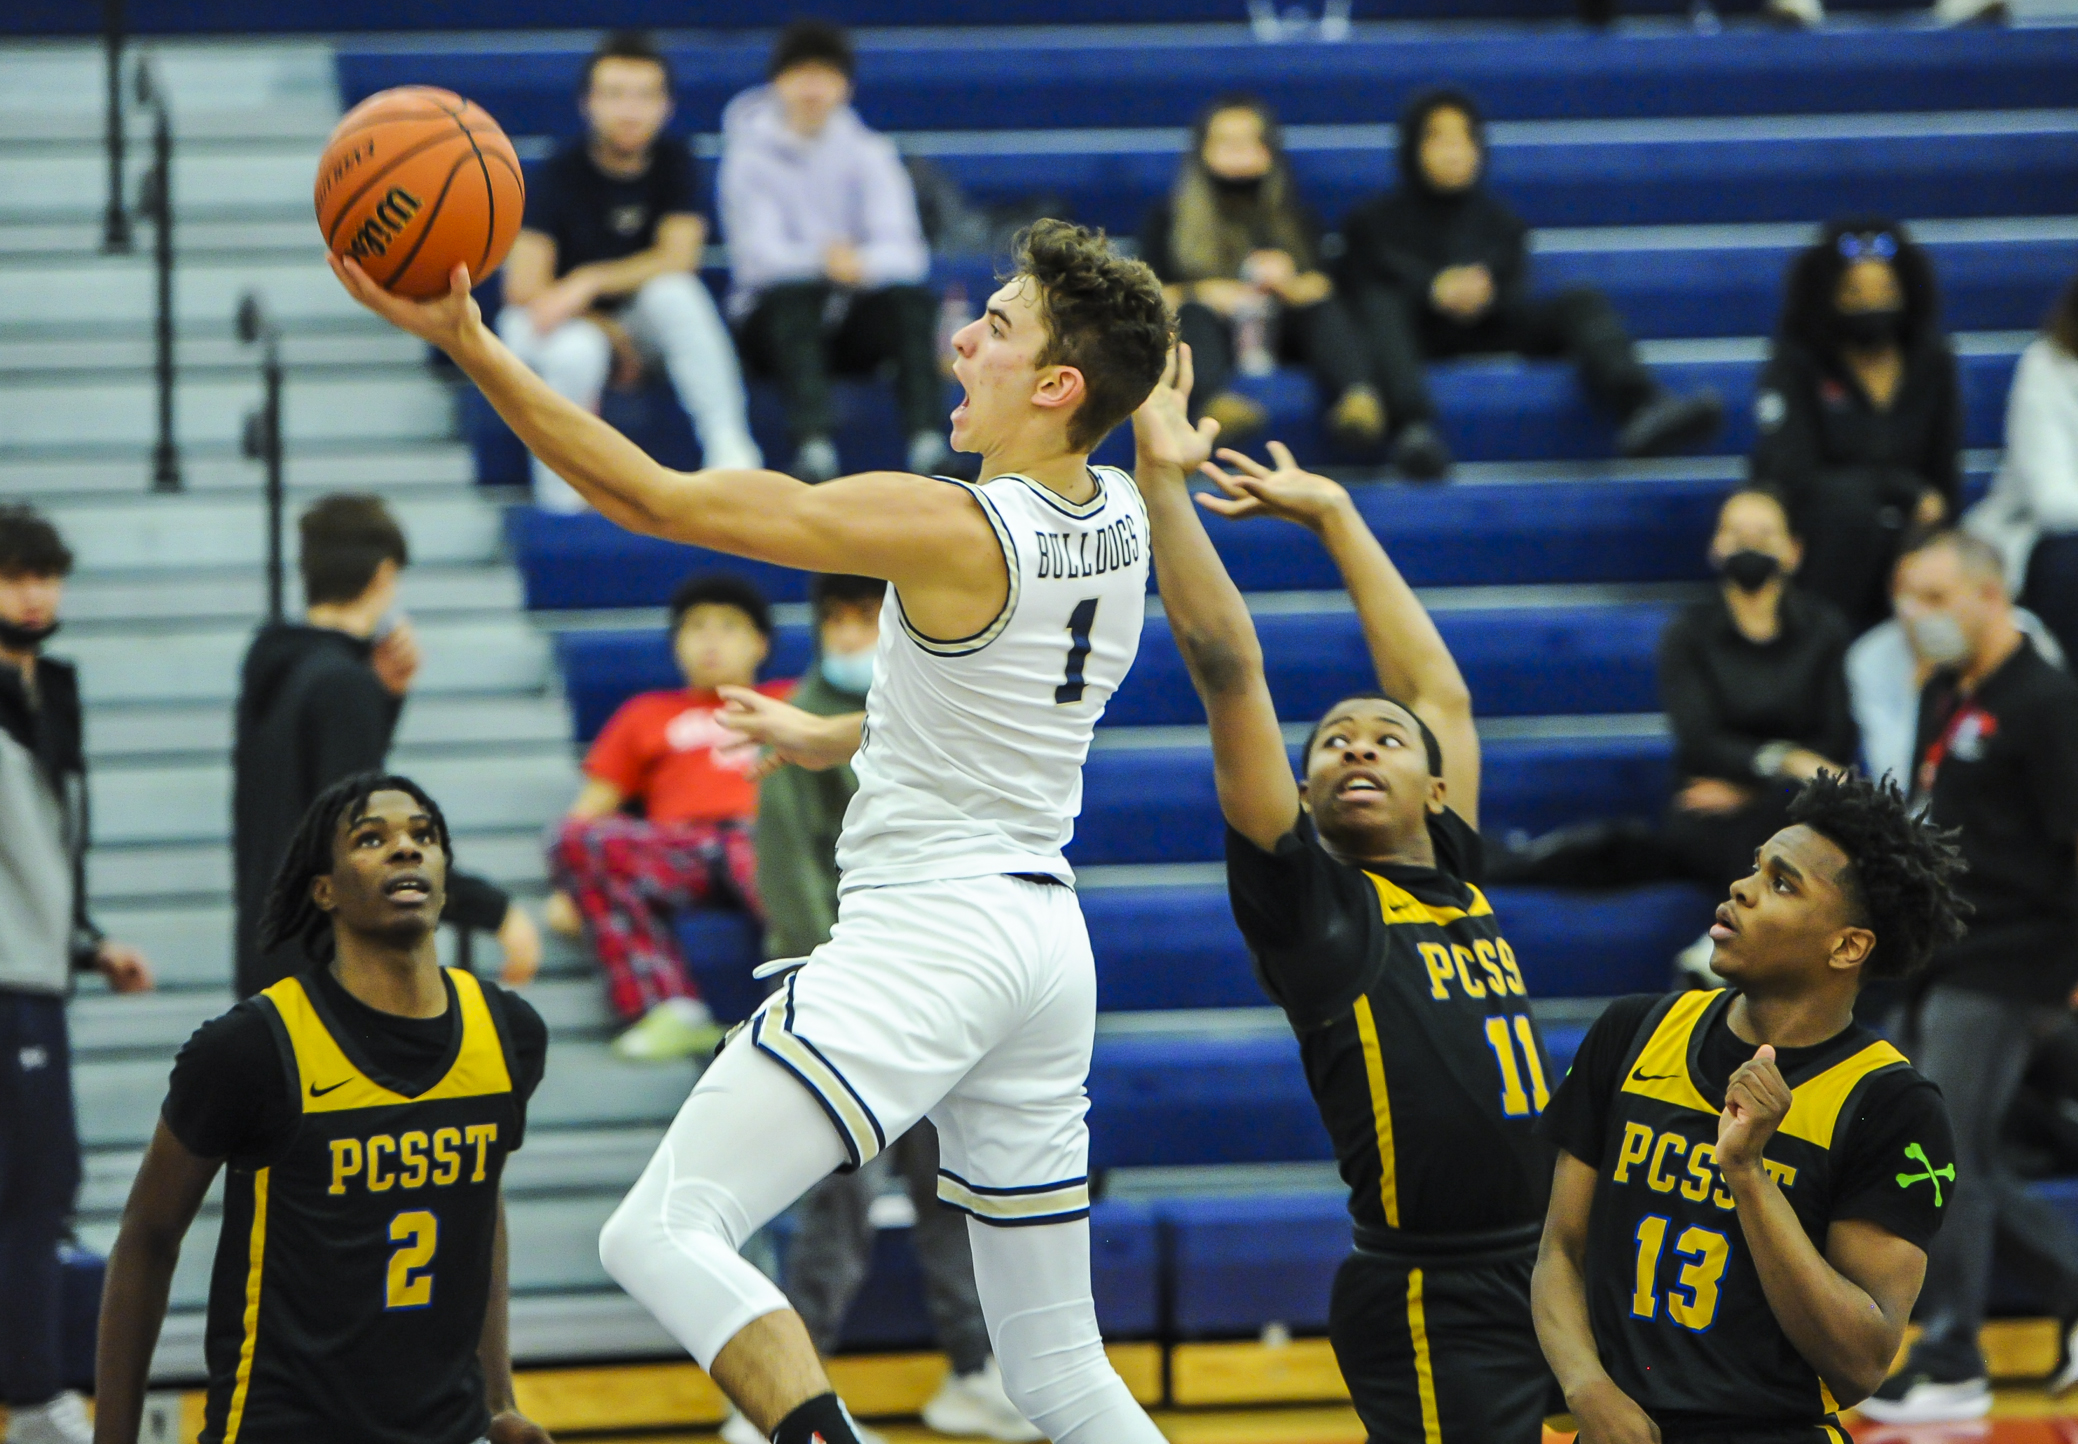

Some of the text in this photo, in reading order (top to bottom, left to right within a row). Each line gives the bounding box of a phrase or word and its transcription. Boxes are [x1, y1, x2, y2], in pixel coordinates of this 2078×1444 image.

[1035, 514, 1139, 579] BULLDOGS
[1055, 596, 1101, 706] 1
[1482, 1013, 1550, 1119] 11
[328, 1122, 498, 1195] PCSST
[384, 1208, 440, 1311] 2
[1629, 1212, 1733, 1333] 13
